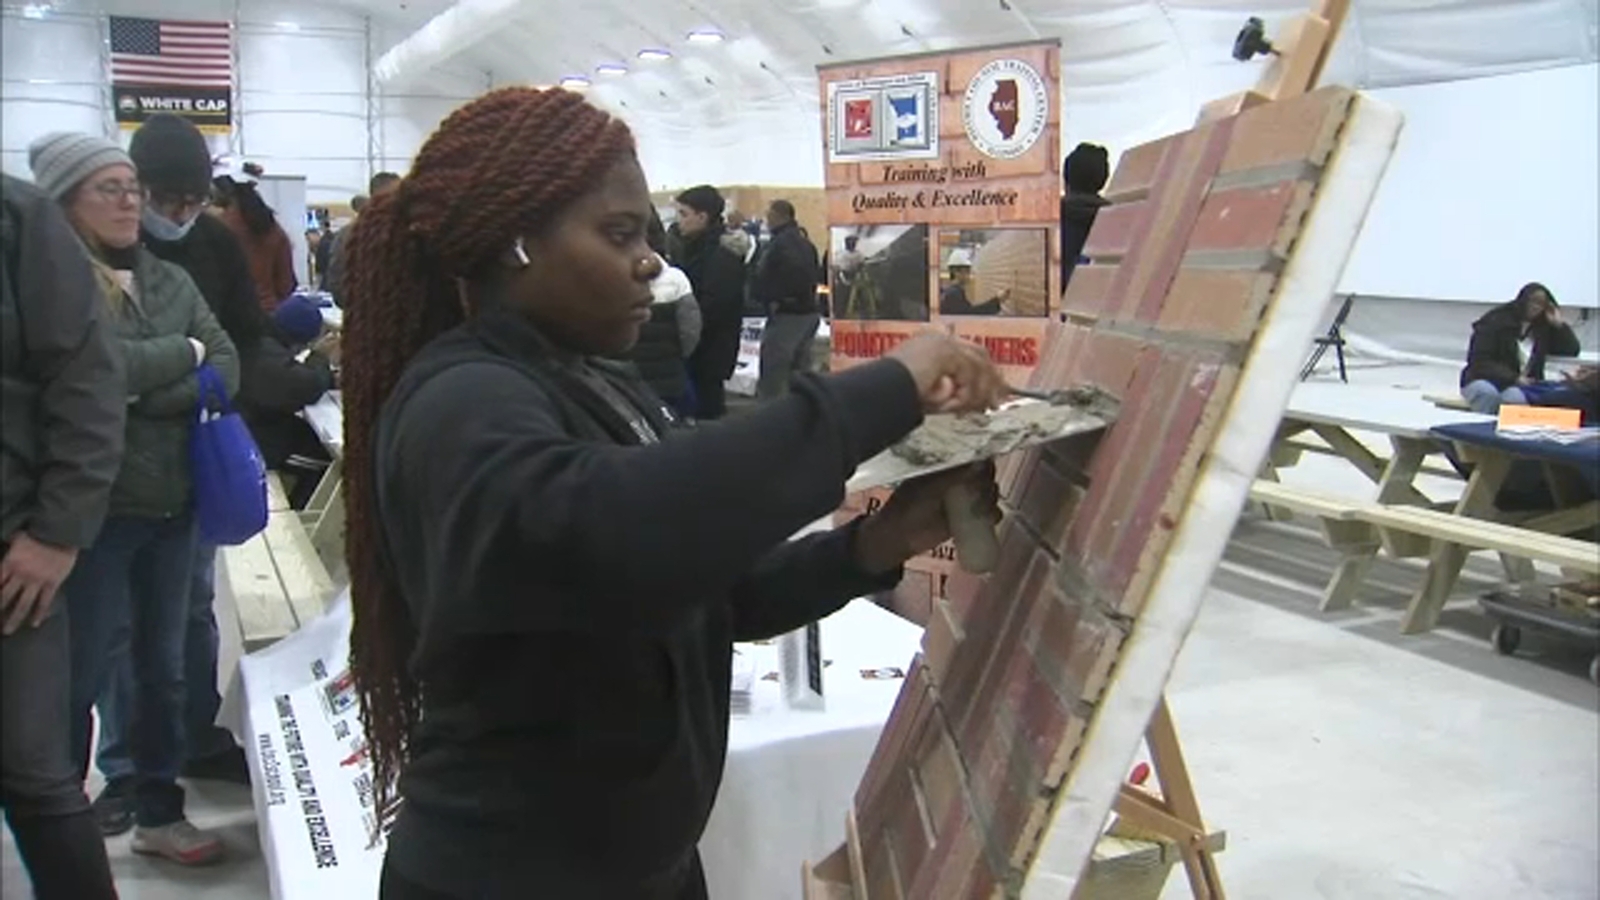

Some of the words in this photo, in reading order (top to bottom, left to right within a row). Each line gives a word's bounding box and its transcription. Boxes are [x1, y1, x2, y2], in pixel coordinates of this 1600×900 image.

[139, 96, 192, 112] WHITE
[195, 98, 227, 112] CAP
[882, 164, 949, 183] Training
[951, 160, 987, 179] with
[851, 191, 909, 213] Quality
[911, 193, 926, 209] &
[931, 189, 1019, 208] Excellence
[834, 331, 912, 358] POINTE
